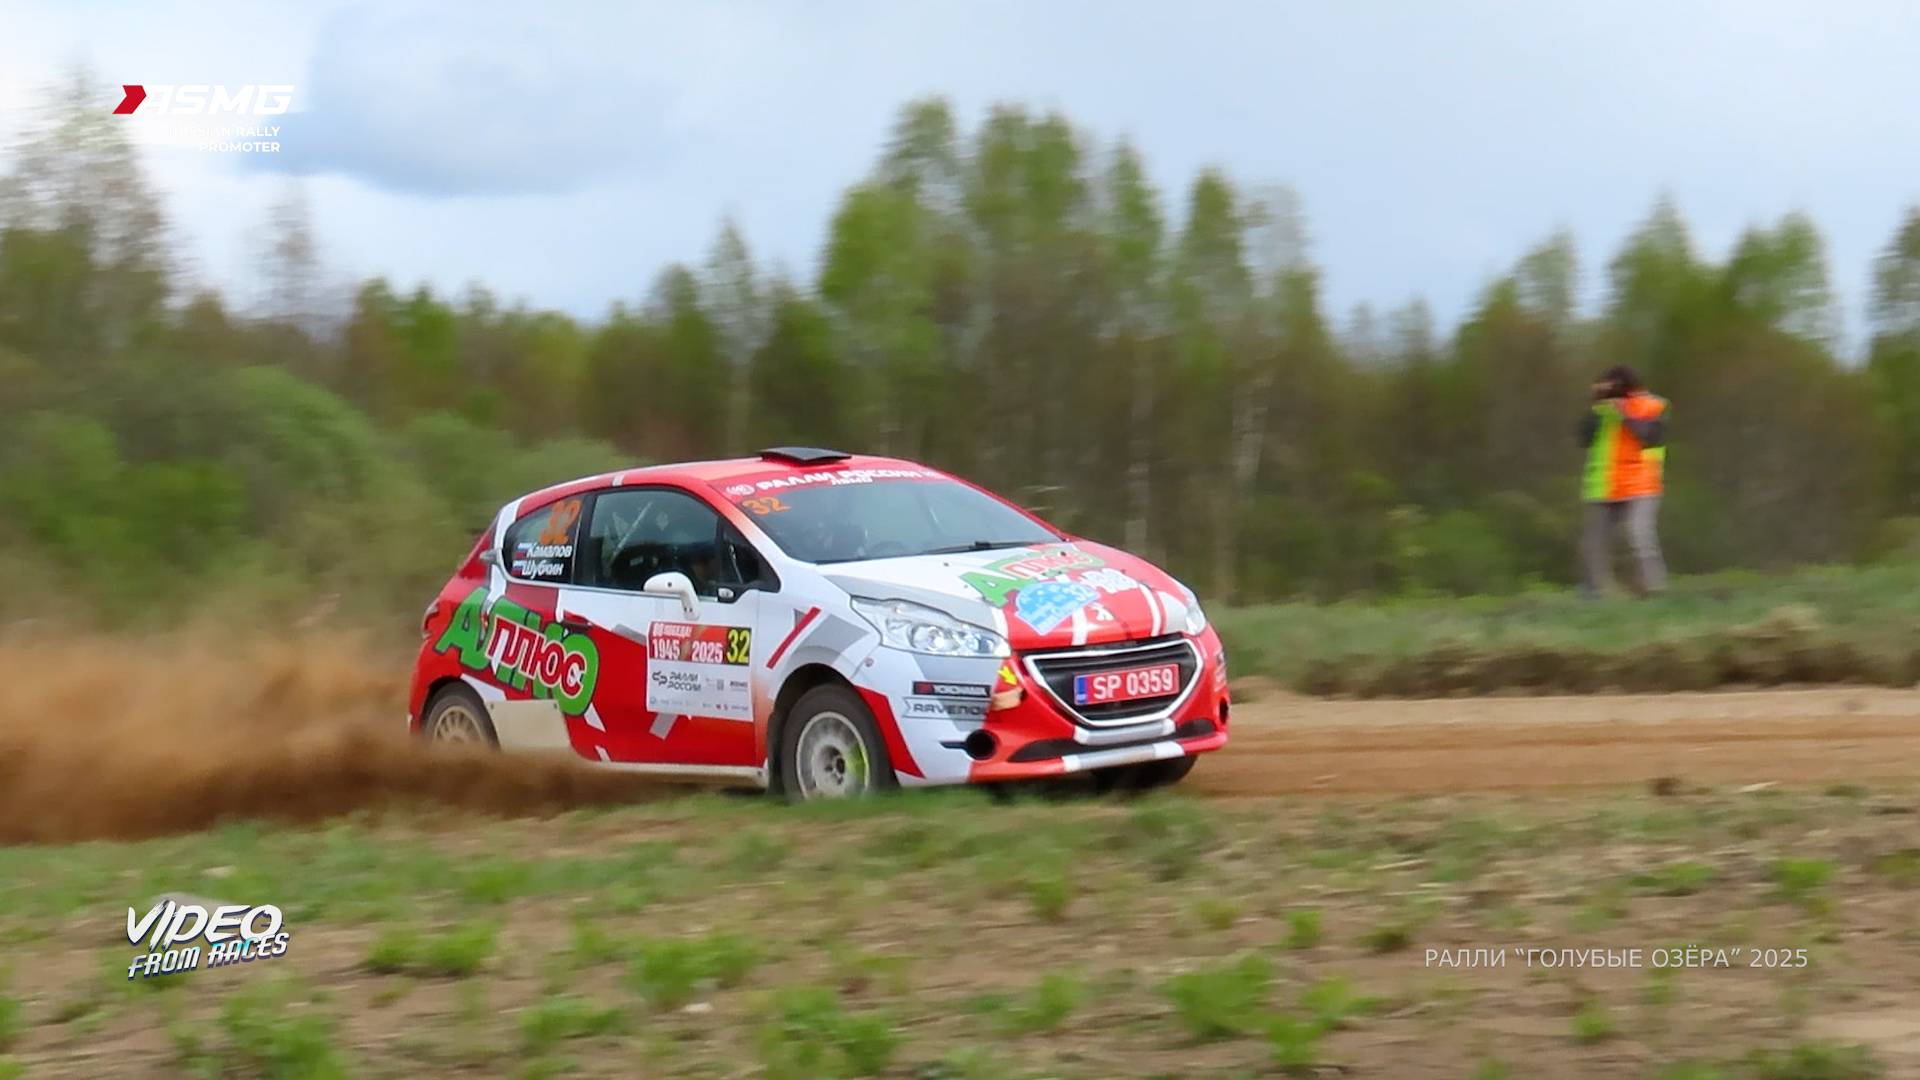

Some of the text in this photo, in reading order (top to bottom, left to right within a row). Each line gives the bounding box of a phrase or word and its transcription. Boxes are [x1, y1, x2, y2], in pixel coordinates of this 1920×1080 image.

[742, 496, 791, 516] 32
[526, 542, 573, 558] Камалов
[485, 615, 587, 699] ПЛЮС
[652, 638, 724, 663] 1945 2025
[726, 628, 751, 664] 32
[1092, 667, 1173, 699] SP 0359
